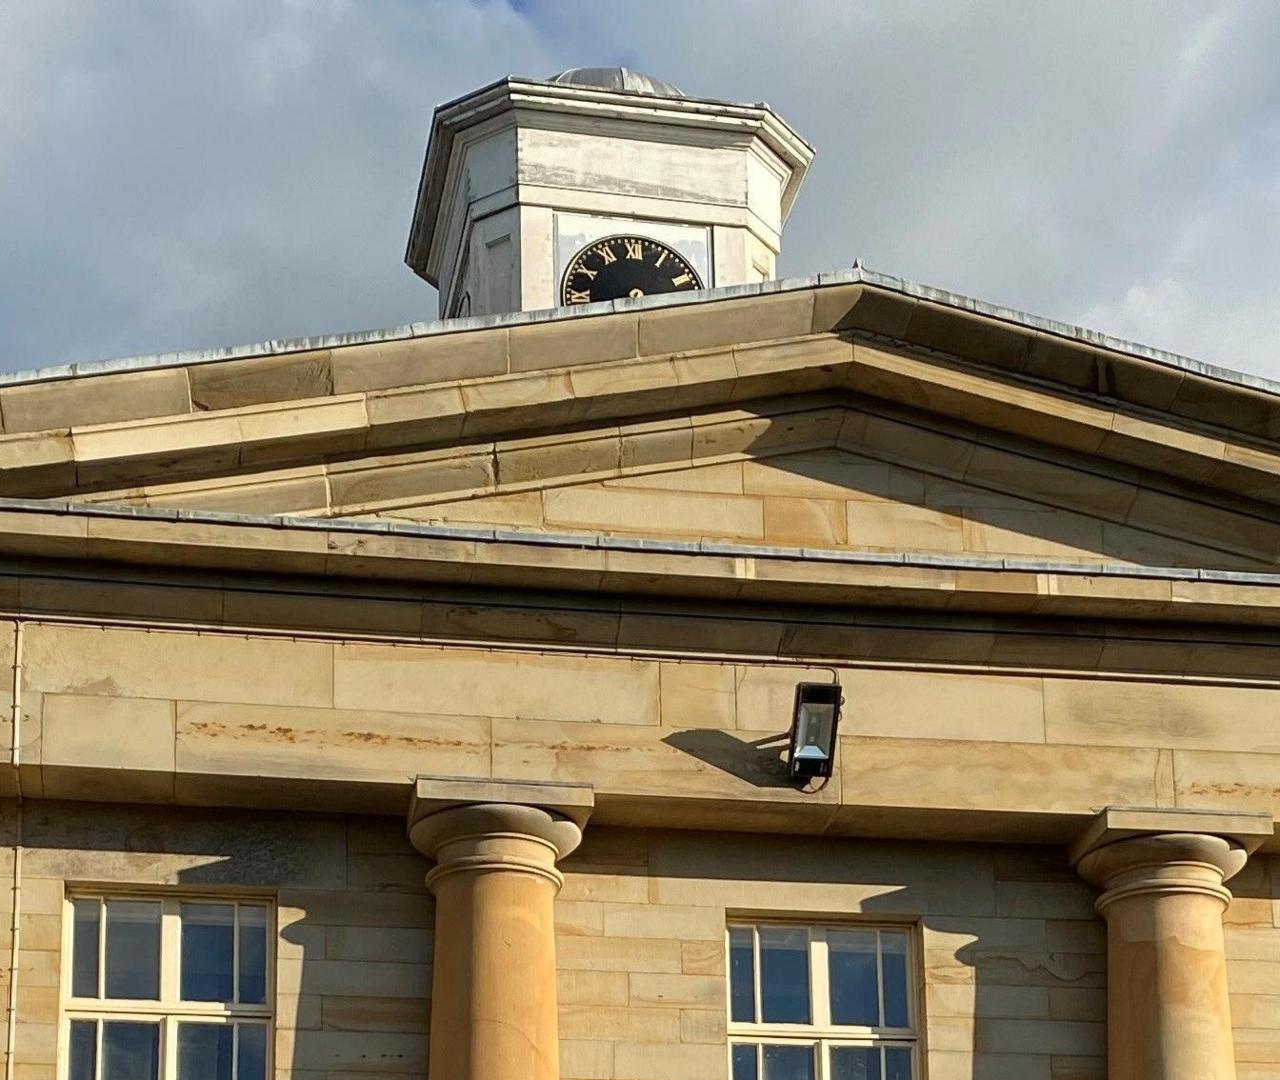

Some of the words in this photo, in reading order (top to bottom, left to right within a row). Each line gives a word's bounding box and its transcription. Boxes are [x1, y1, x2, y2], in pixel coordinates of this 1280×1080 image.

[597, 246, 617, 265] XI
[625, 243, 642, 260] XII
[654, 252, 667, 268] I
[577, 264, 598, 280] X
[571, 288, 590, 303] IX
